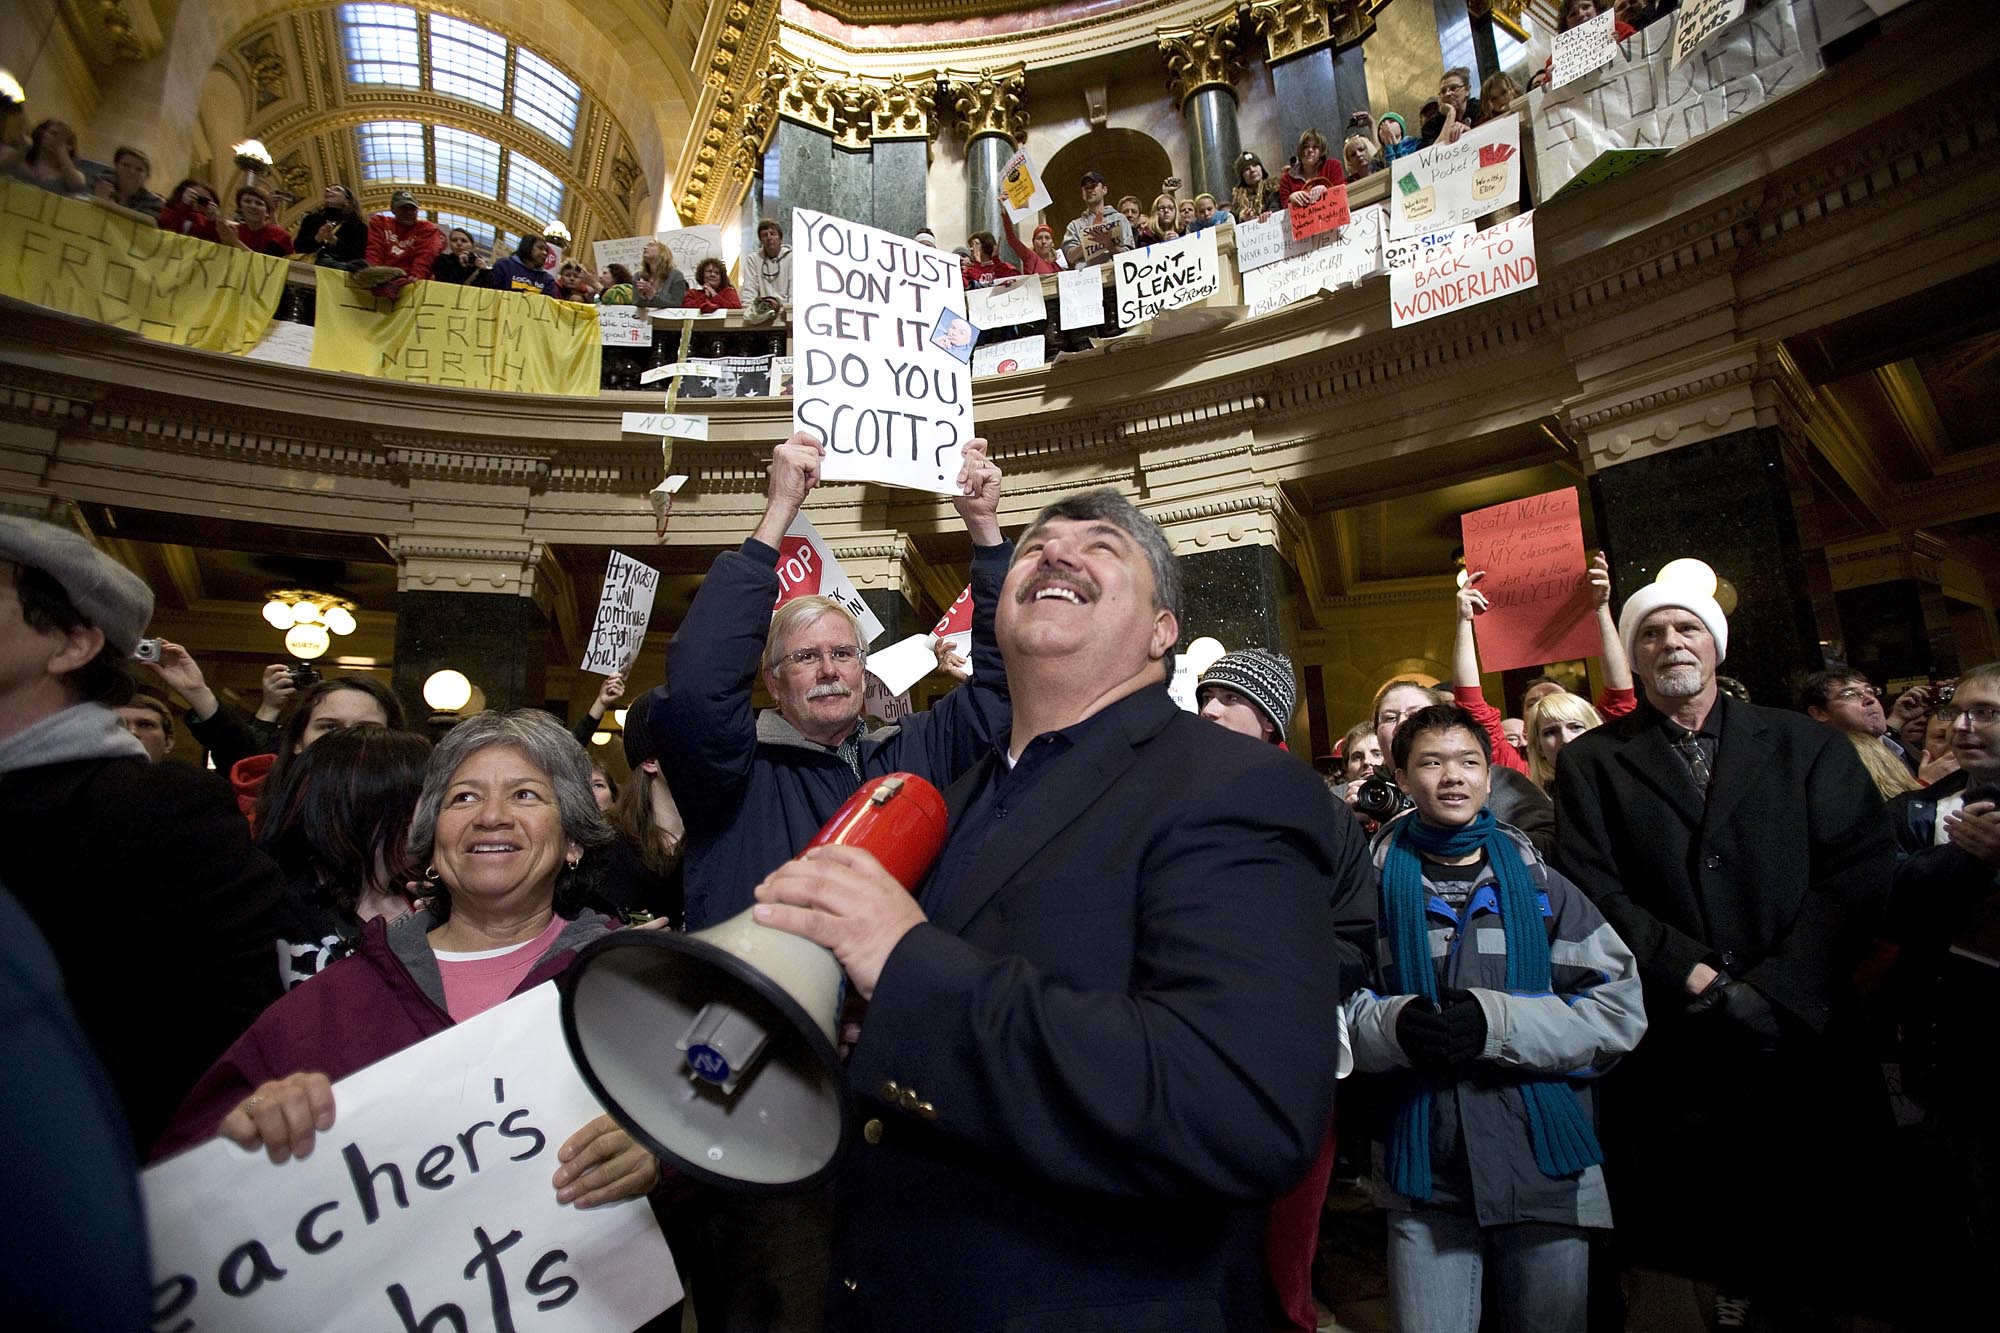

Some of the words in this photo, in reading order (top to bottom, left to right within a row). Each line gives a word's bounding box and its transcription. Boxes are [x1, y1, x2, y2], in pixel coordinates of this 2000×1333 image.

[1554, 30, 1588, 51] EMAIL
[1596, 17, 1609, 27] TO
[1555, 27, 1583, 43] CALL
[1590, 14, 1604, 26] OR
[1565, 28, 1599, 51] THANK
[1556, 45, 1583, 61] YOUR
[1559, 34, 1609, 64] SENATOR
[1418, 142, 1471, 169] Whose
[1240, 222, 1261, 237] THE
[1240, 227, 1280, 249] UNITED
[1421, 230, 1456, 248] Slow
[1463, 212, 1533, 250] PARTY
[796, 211, 869, 263] YOU
[877, 239, 957, 289] JUST
[1240, 248, 1263, 264] NEVER
[1414, 254, 1471, 289] BACK
[1481, 239, 1514, 261] TO
[19, 229, 180, 317] FROM
[1122, 251, 1185, 285] DON'T
[1137, 257, 1202, 299] LEAVE!
[816, 260, 931, 313] DON'T
[1393, 256, 1536, 321] WONDERLAND
[415, 312, 523, 352] FROM
[804, 303, 880, 342] GET
[896, 317, 930, 352] IT
[381, 347, 526, 381] NORTH
[651, 363, 709, 376] ARE
[806, 349, 869, 388] DO
[884, 358, 965, 416] YOU,
[639, 416, 701, 434] NOT
[797, 397, 959, 481] SCOTT?
[1467, 508, 1510, 533] Scott
[1516, 494, 1571, 523] Walker
[1471, 538, 1484, 553] is
[1490, 527, 1515, 549] not
[1520, 521, 1572, 541] welcome
[607, 551, 633, 589] Hey
[630, 562, 658, 593] Kids!
[1486, 545, 1519, 570] MY
[602, 584, 616, 601] I
[616, 585, 635, 610] will
[598, 604, 646, 627] continue
[587, 642, 617, 671] you!
[884, 698, 909, 719] child
[150, 1077, 546, 1333] eacher's
